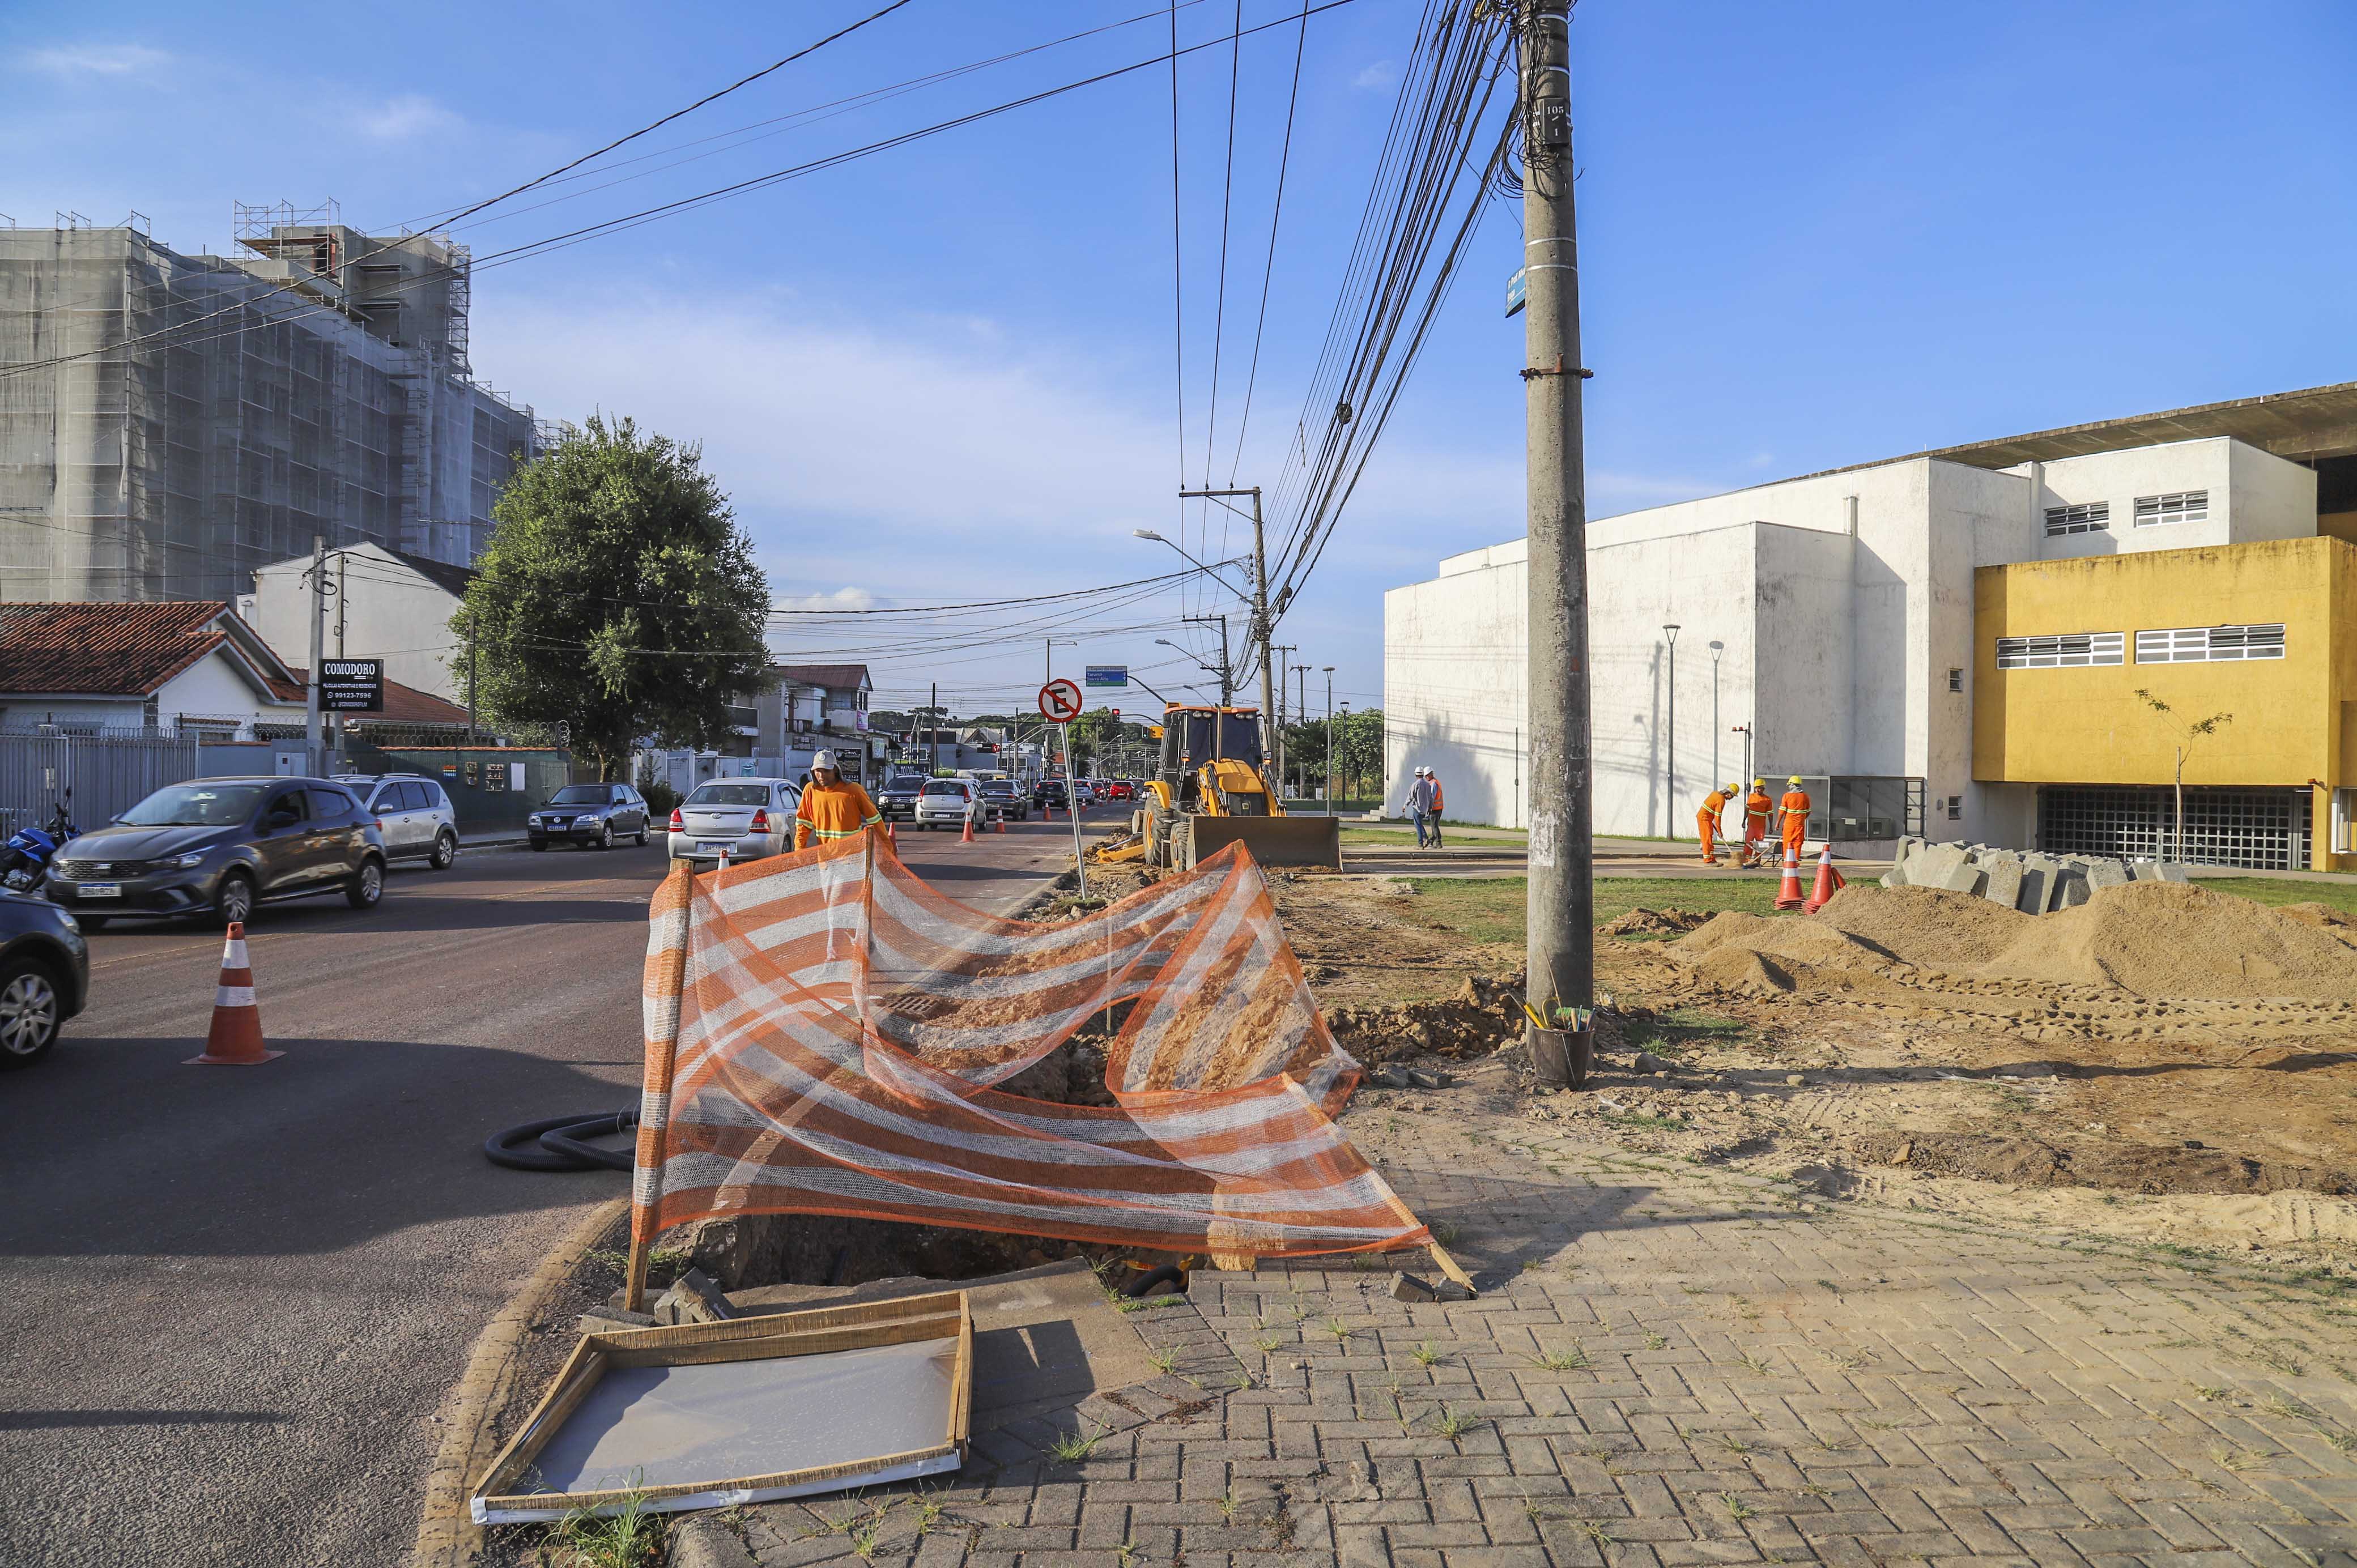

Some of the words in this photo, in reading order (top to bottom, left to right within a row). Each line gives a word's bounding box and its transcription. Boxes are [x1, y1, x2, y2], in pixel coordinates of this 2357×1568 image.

[1547, 106, 1564, 114] 105
[1554, 128, 1558, 137] 1
[325, 663, 375, 675] COMODORO
[1052, 688, 1070, 714] E
[900, 766, 914, 776] TOLDOS
